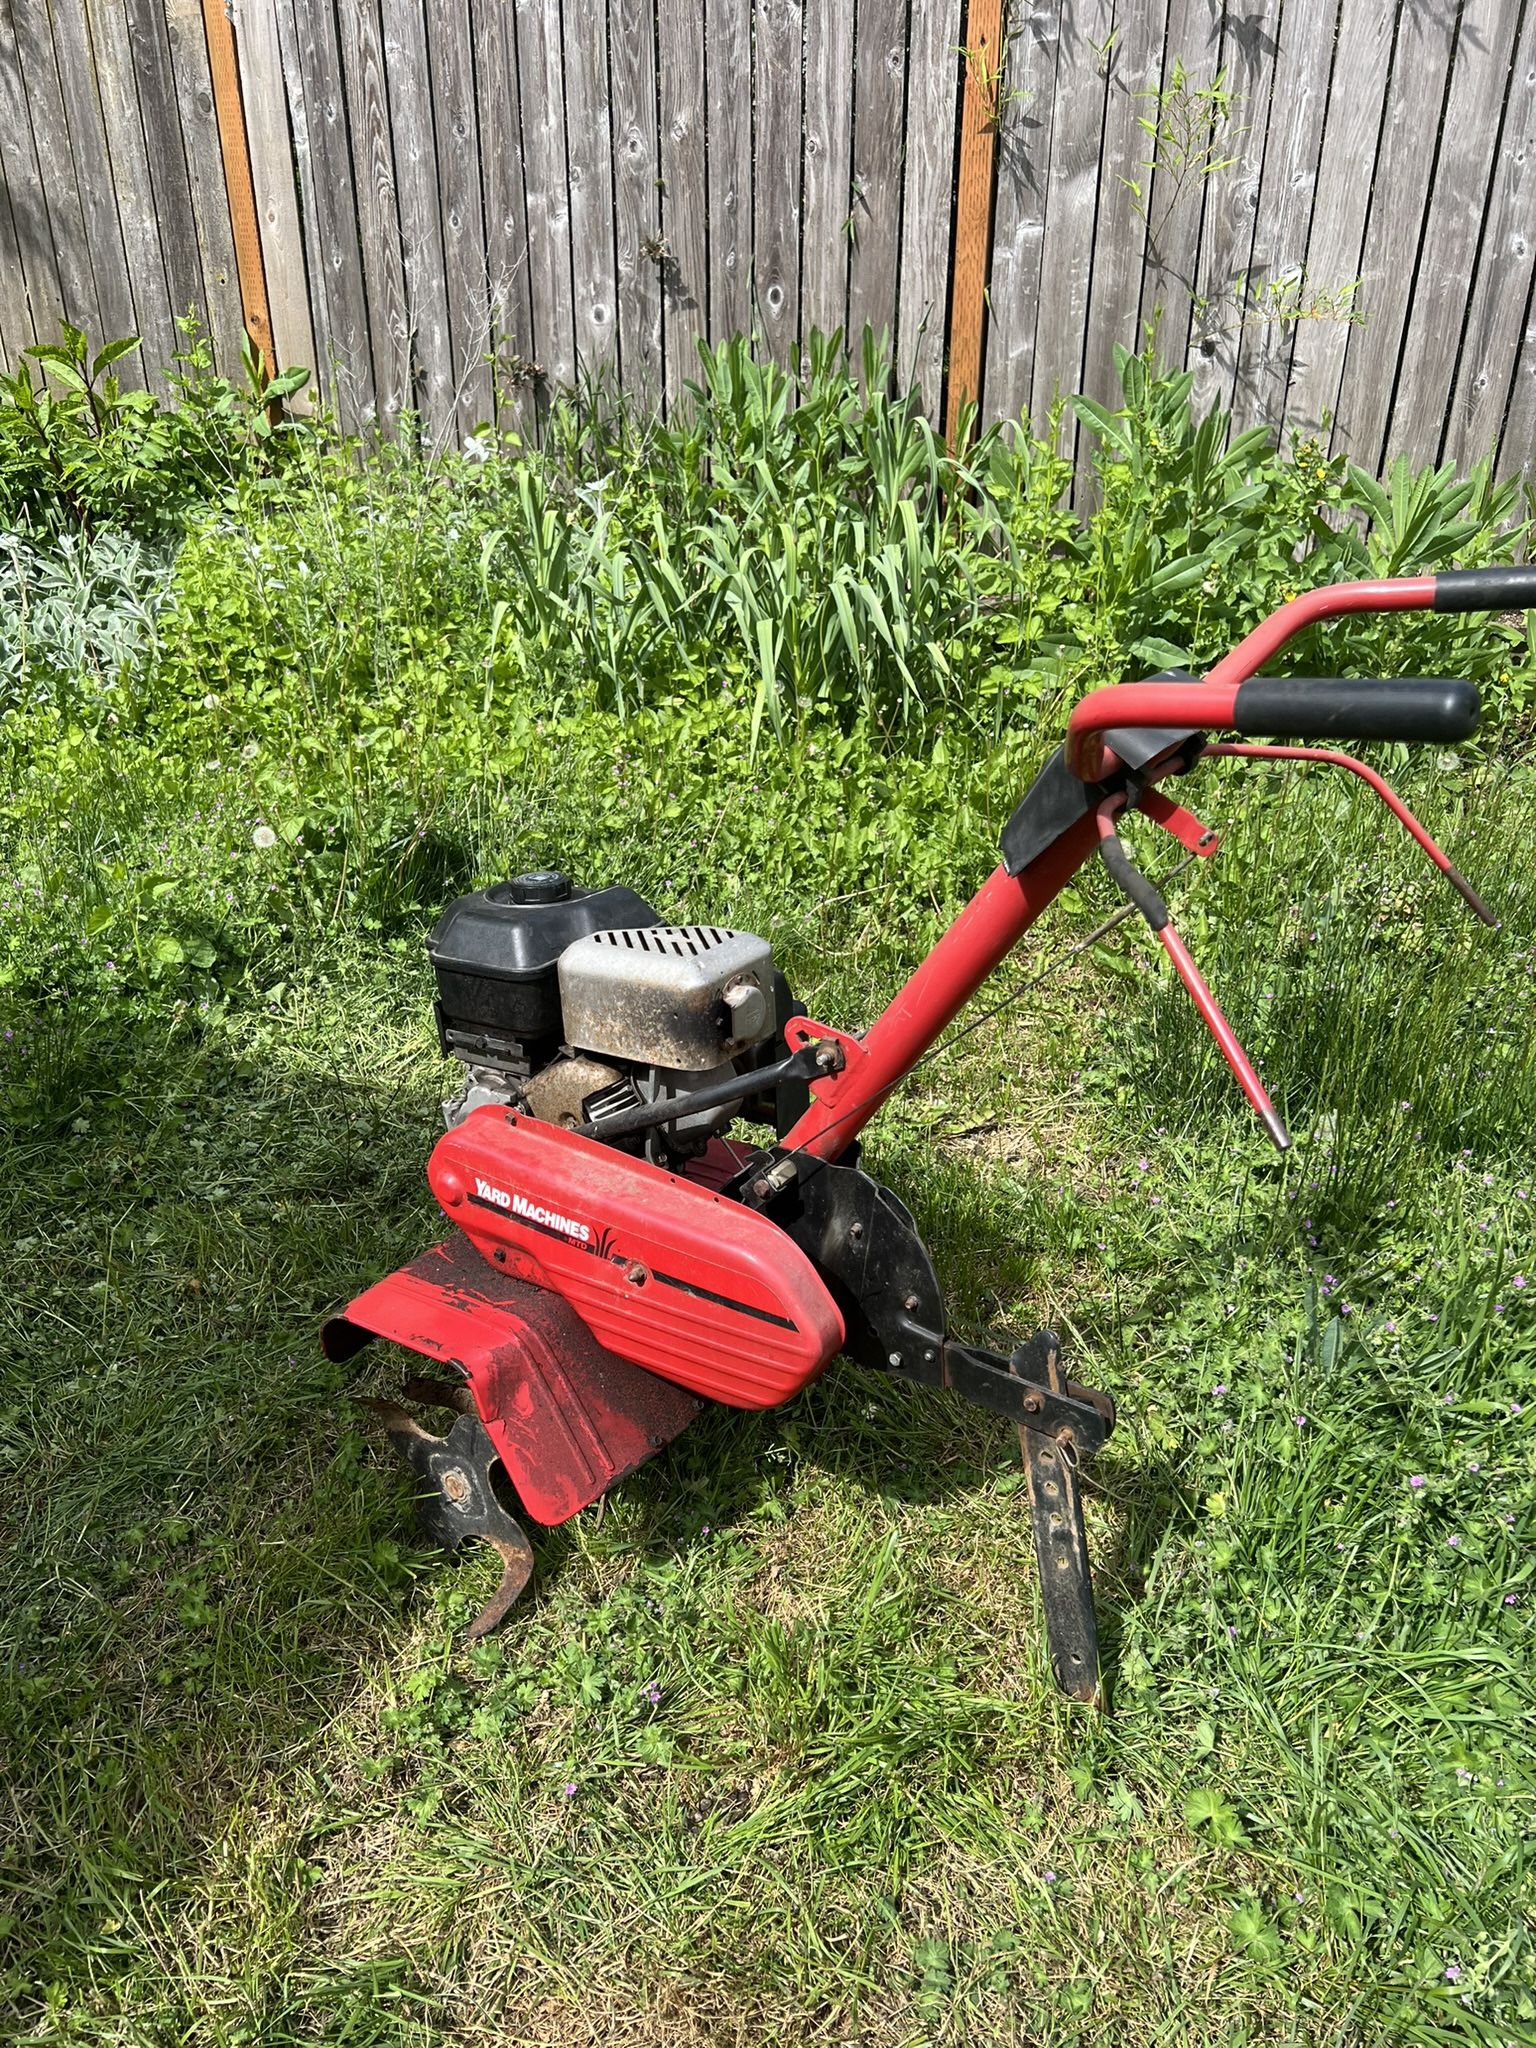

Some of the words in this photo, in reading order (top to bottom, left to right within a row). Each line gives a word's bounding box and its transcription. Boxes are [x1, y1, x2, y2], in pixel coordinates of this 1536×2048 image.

[475, 1177, 510, 1208] YARD
[512, 1194, 590, 1241] MACHINES
[567, 1237, 588, 1250] MTD
